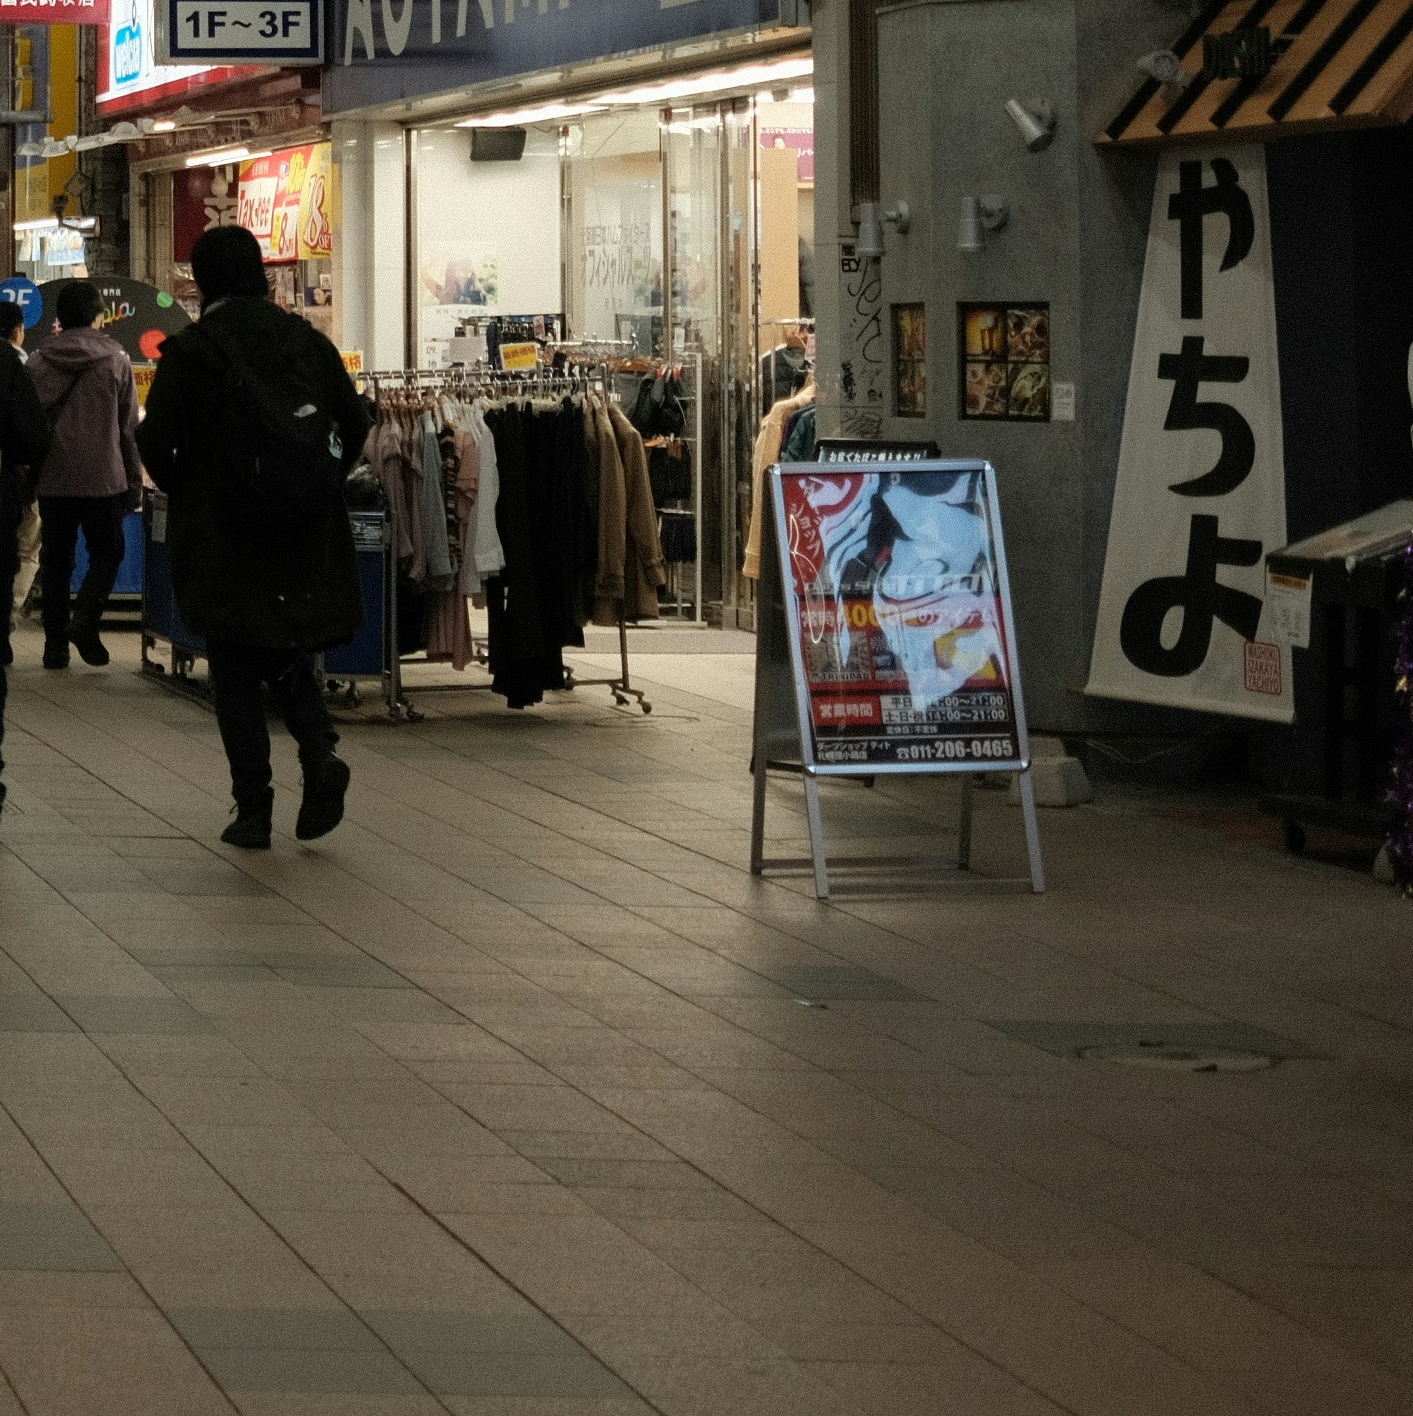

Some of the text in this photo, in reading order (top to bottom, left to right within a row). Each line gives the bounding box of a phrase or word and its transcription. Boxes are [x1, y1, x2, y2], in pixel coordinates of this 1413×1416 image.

[1120, 157, 1263, 677] やちよ
[819, 703, 873, 718] 営業時間
